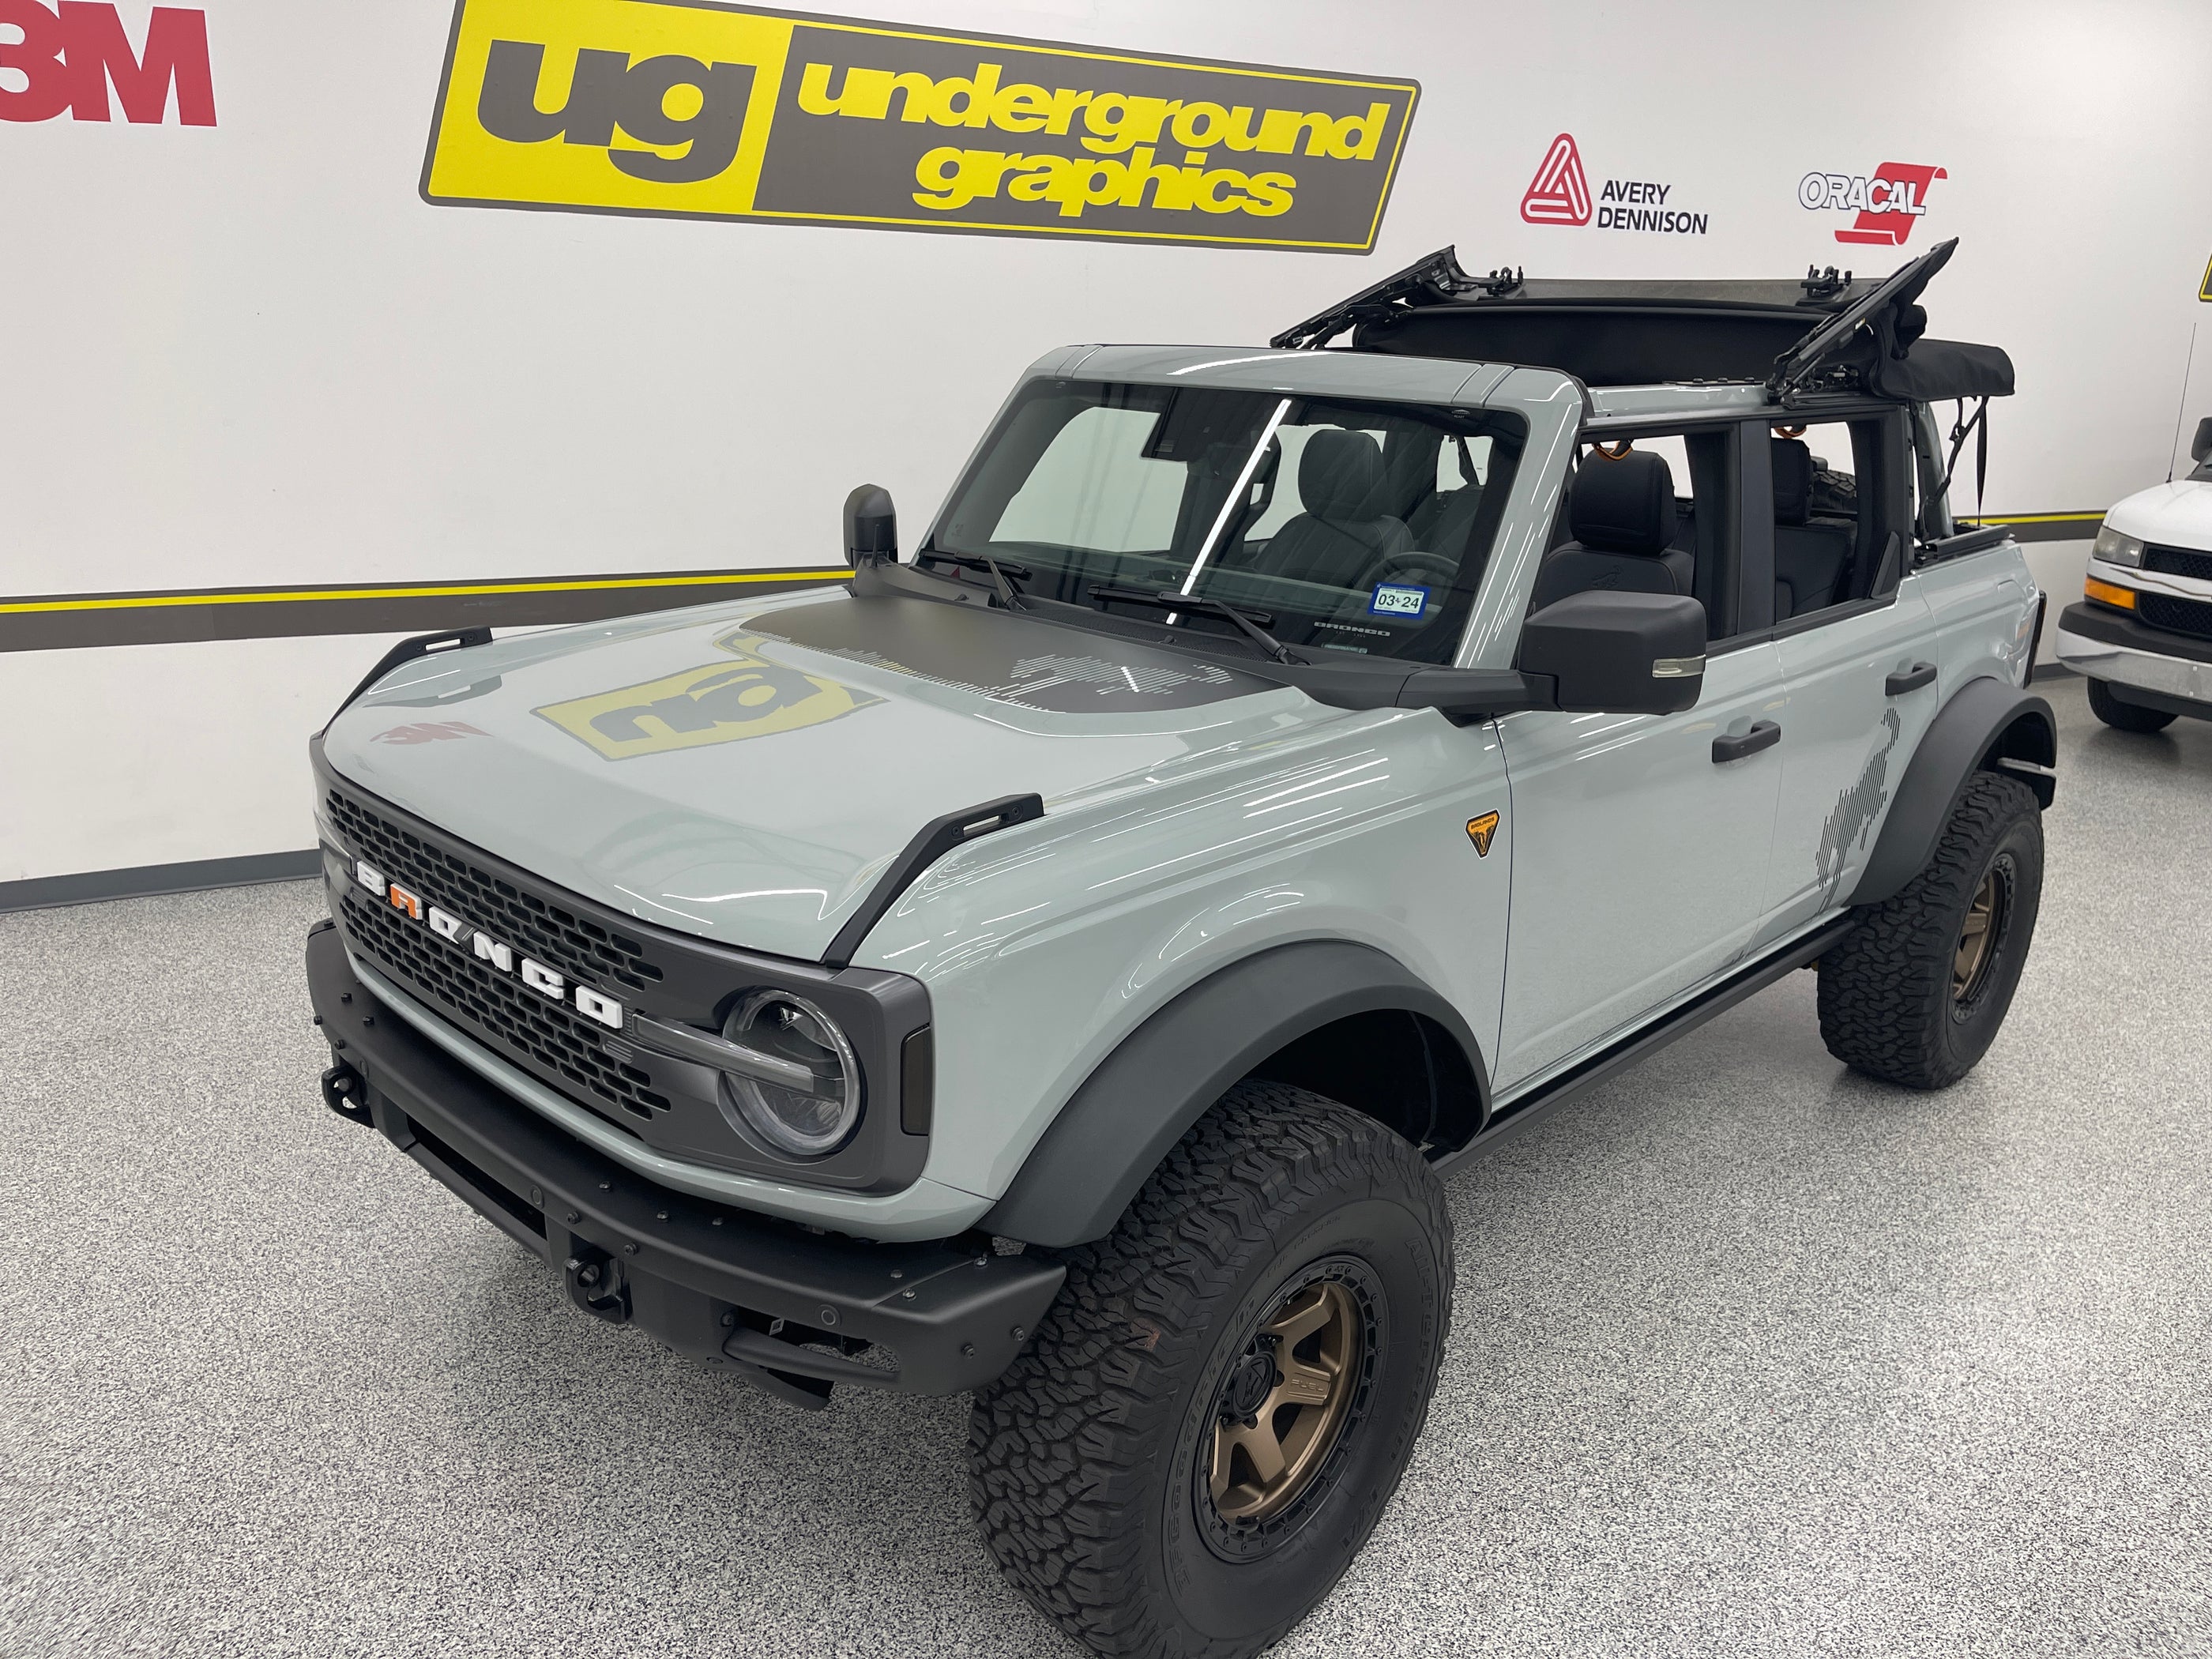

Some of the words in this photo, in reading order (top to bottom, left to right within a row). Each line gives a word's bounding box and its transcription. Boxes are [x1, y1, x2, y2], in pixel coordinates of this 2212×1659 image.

[0, 0, 217, 126] 3M
[477, 40, 756, 183] ug
[797, 62, 1390, 161] underground
[912, 146, 1296, 217] graphics
[1601, 179, 1671, 205] AVERY
[1798, 171, 1926, 216] ORACAL
[1597, 208, 1708, 235] DENNISON
[1378, 594, 1395, 607] 03
[1401, 596, 1420, 608] 24
[357, 860, 623, 1030] BRONCO
[1290, 1378, 1324, 1392] FUEL
